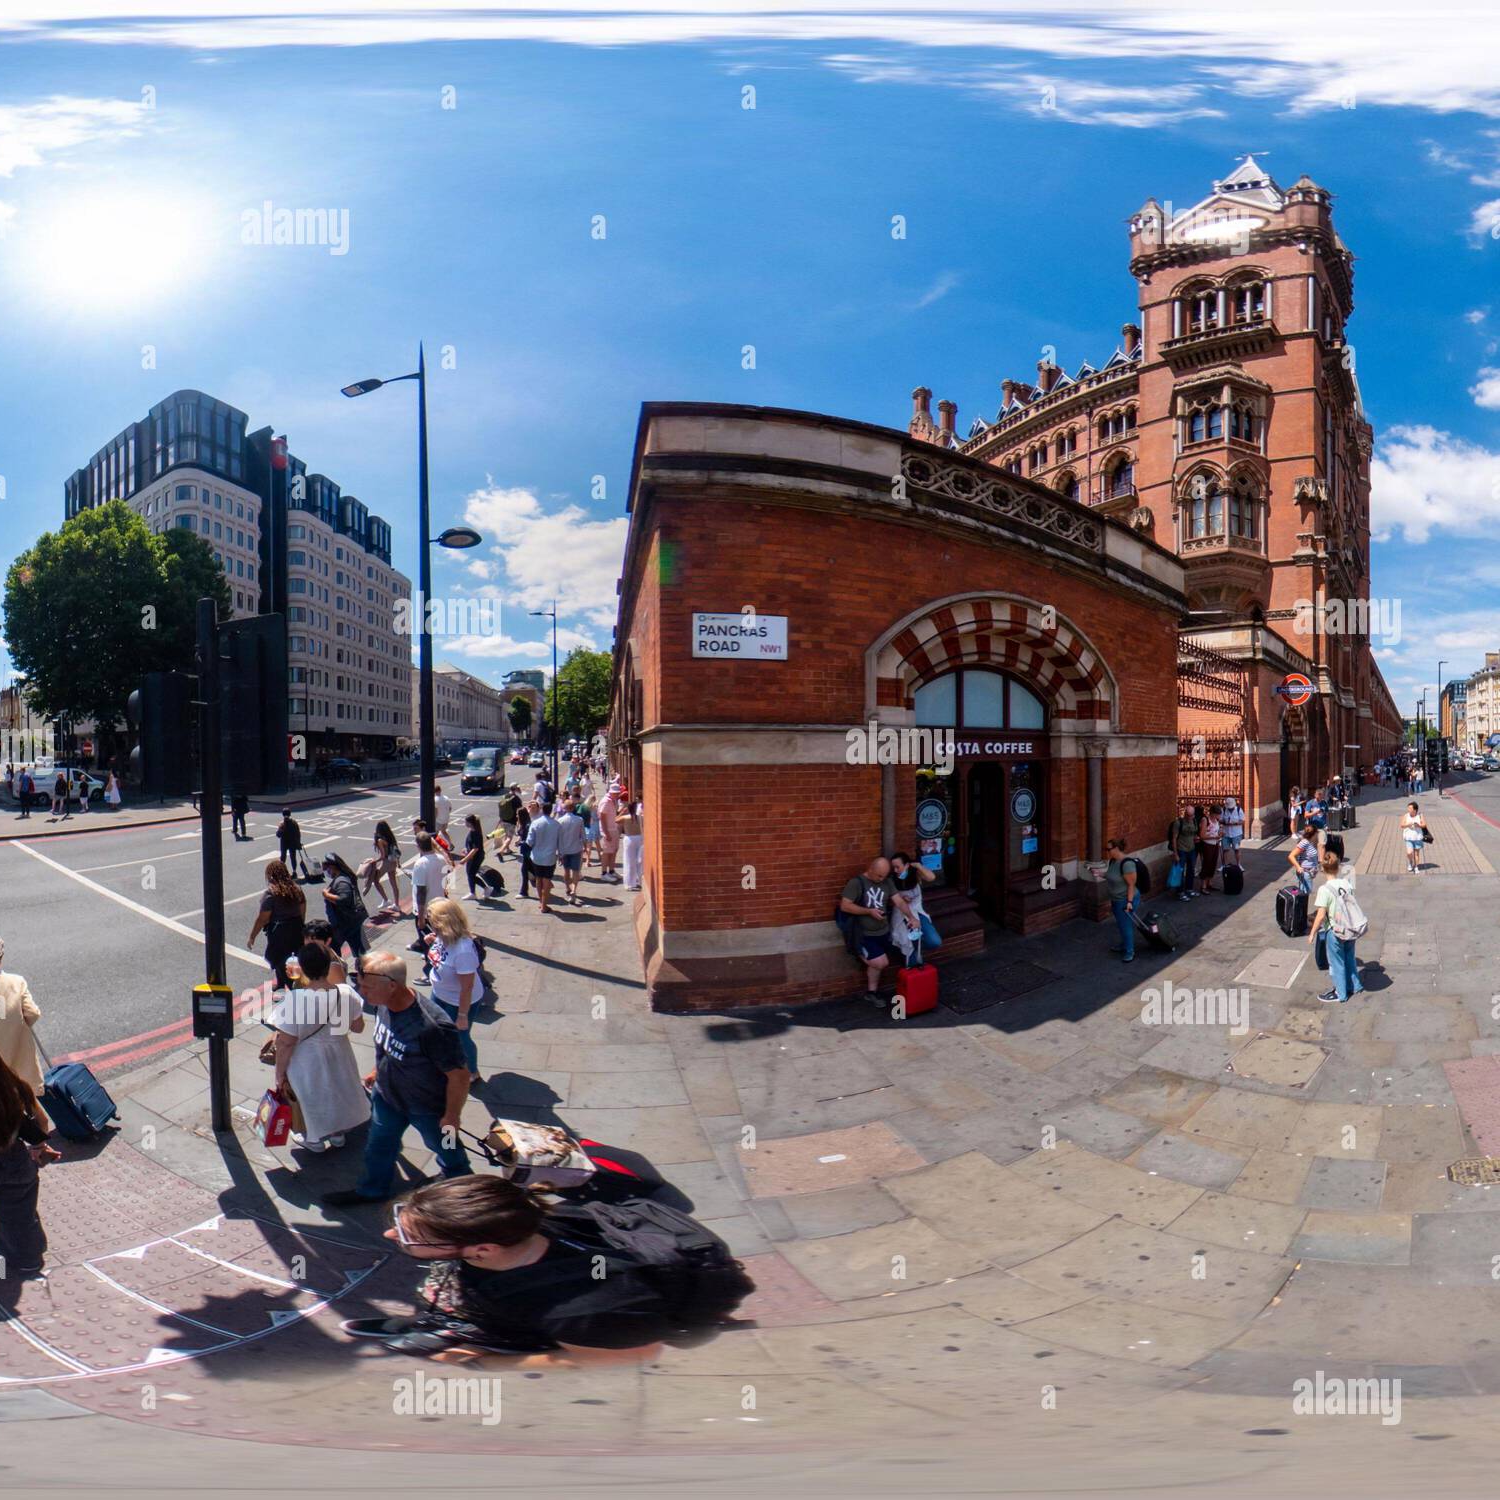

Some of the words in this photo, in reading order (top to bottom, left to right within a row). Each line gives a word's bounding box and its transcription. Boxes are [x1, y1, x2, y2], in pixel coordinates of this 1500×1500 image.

[698, 625, 768, 637] PANCRAS
[698, 640, 741, 652] ROAD
[760, 644, 782, 653] NW1
[936, 742, 980, 755] COSTA
[985, 742, 1033, 754] COFFEE
[866, 886, 885, 908] NY
